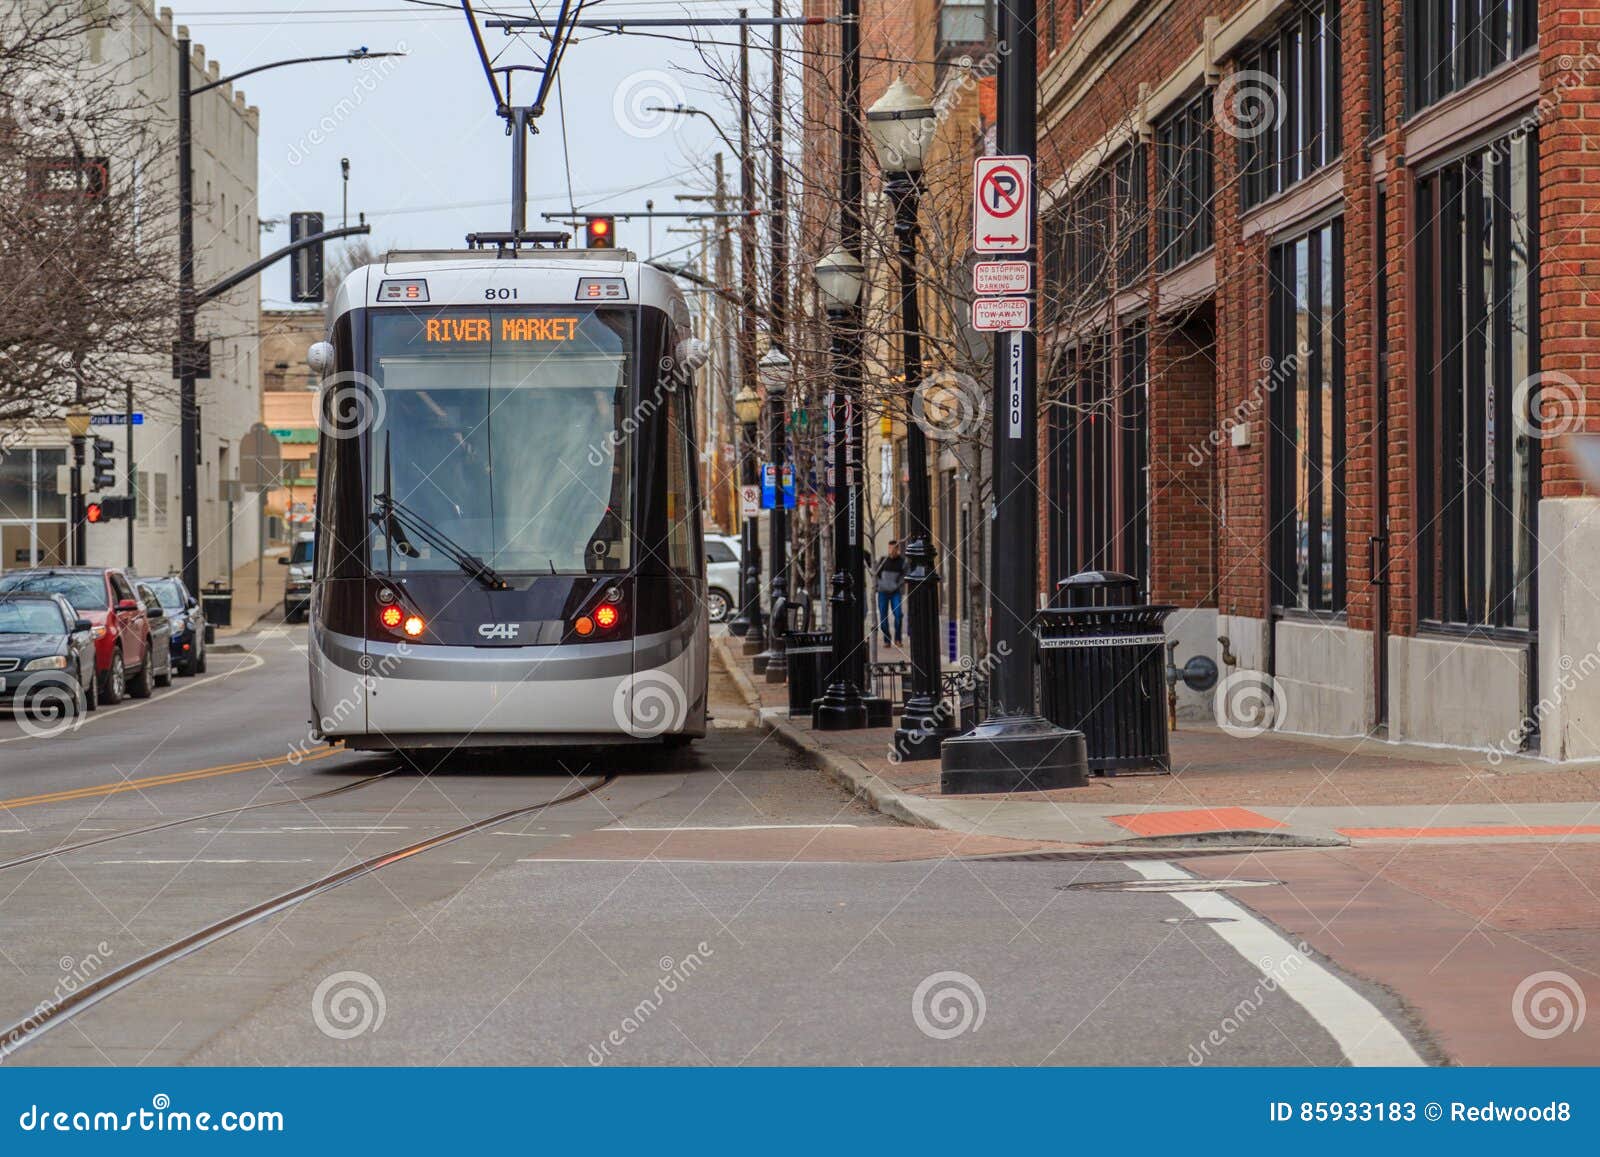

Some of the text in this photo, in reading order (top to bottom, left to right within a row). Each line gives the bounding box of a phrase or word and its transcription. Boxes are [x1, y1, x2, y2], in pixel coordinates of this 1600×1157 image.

[991, 265, 1026, 273] STOPPING
[485, 288, 518, 300] 801
[990, 319, 1012, 327] ZONE
[427, 317, 578, 342] RIVER MARKET
[1011, 345, 1020, 424] 51180
[478, 623, 520, 639] CAF
[1058, 638, 1109, 646] IMPROVEMENT
[1112, 637, 1144, 645] DISTRICT
